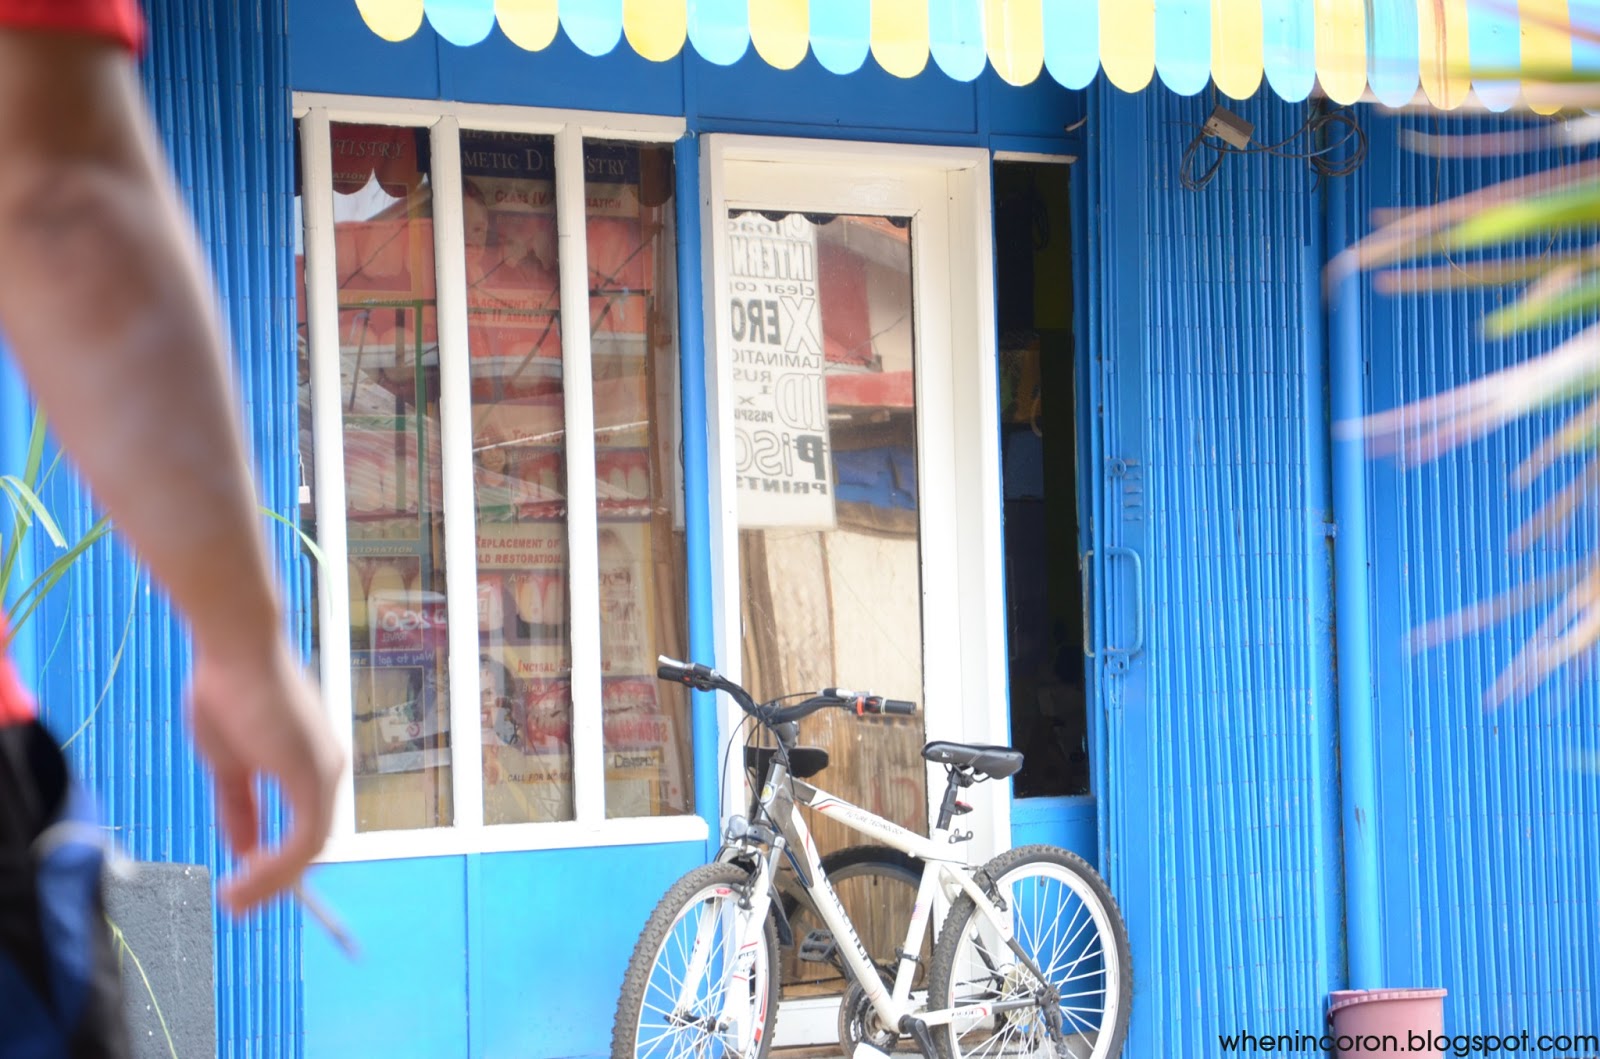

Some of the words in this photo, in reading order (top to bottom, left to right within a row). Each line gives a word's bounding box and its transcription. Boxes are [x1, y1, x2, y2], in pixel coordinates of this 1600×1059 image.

[337, 138, 407, 160] TISTRY
[463, 151, 519, 170] METIC
[333, 170, 367, 181] ATION
[476, 535, 543, 549] REPLACEMENT
[547, 538, 560, 549] OF
[476, 553, 491, 564] LD
[495, 553, 561, 564] RESTORATION
